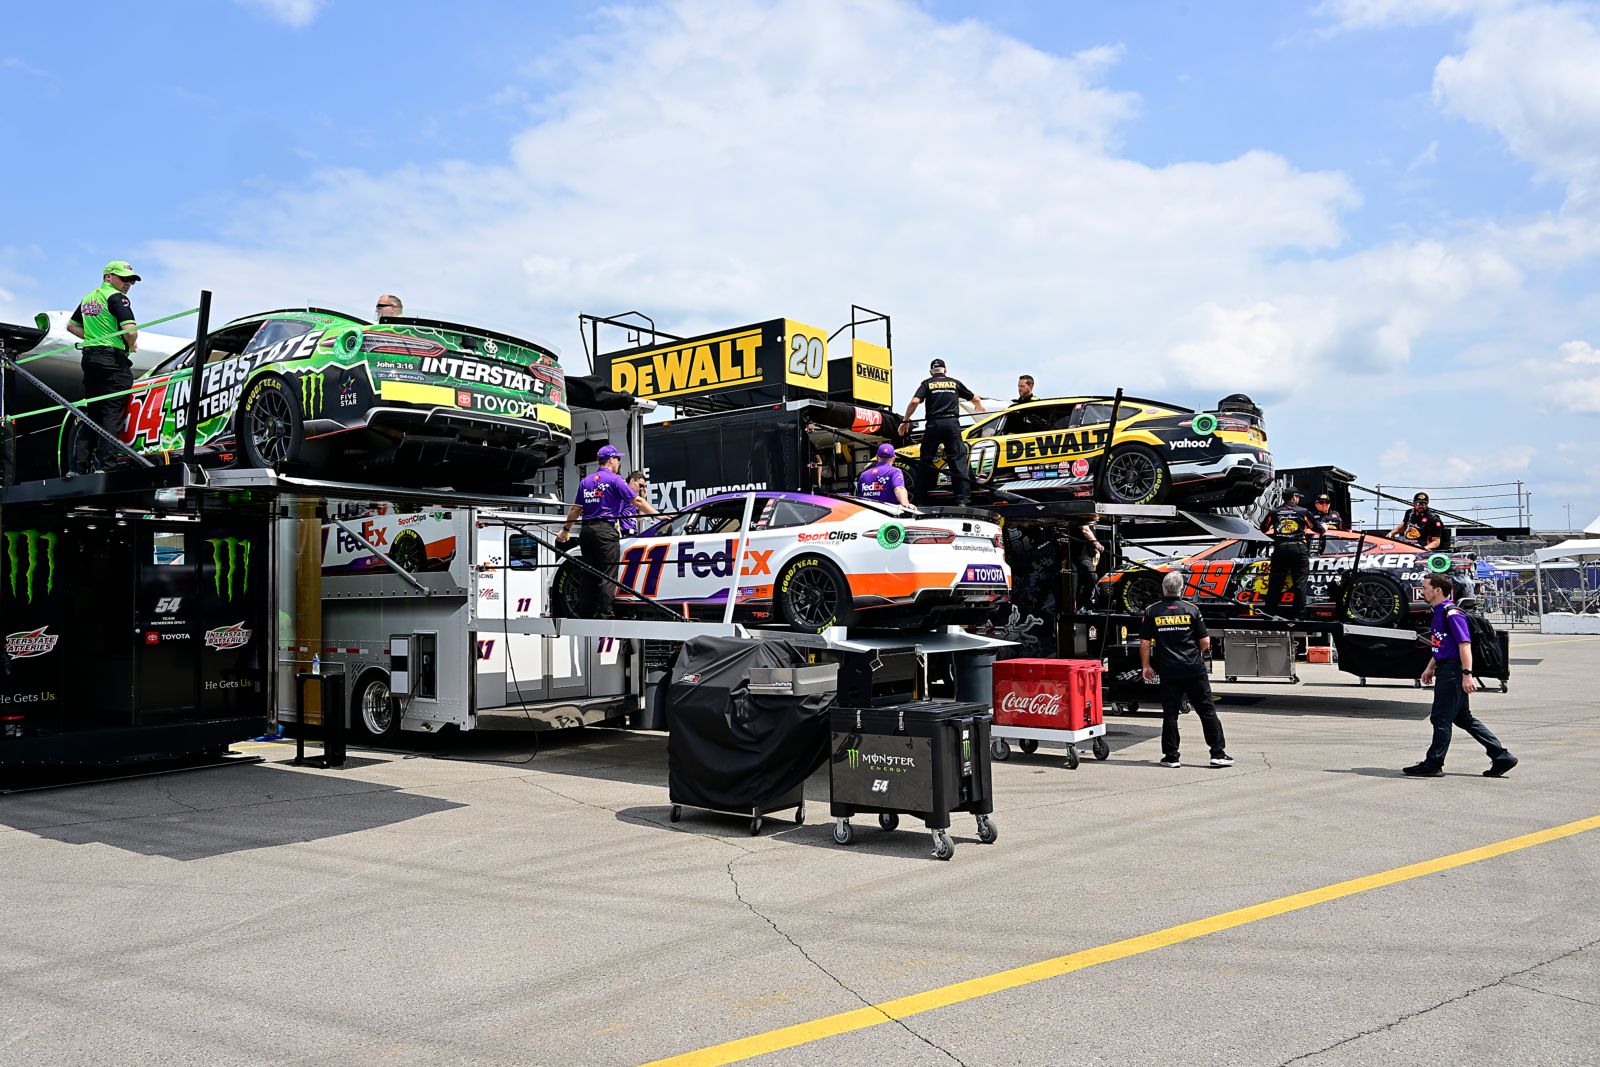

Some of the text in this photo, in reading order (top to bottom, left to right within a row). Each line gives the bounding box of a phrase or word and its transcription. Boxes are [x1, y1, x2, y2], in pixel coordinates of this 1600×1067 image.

[788, 333, 824, 379] 20
[611, 334, 762, 397] DEWALT
[856, 363, 889, 383] DEWALT
[421, 357, 545, 394] INTERSTATE
[340, 392, 357, 400] FIVE
[340, 399, 357, 407] STAR
[474, 394, 536, 419] TOYOTA
[1006, 429, 1110, 460] DEWALT
[1169, 437, 1213, 450] yahoo!
[862, 482, 885, 491] FedEx
[646, 480, 686, 513] EXT
[337, 520, 388, 554] FedEx
[677, 538, 774, 578] FedEx
[616, 542, 671, 598] 11
[781, 559, 819, 593] GOODYEAR
[975, 568, 1004, 582] TOYOTA
[1401, 571, 1425, 581] BOA
[1184, 560, 1234, 597] 19
[155, 597, 182, 613] 54
[516, 598, 532, 613] 11
[1154, 615, 1191, 627] DEWALT
[7, 644, 53, 652] ATTERIES
[8, 637, 57, 645] TERSTATE
[597, 636, 614, 654] 11
[205, 681, 218, 690] He
[219, 680, 239, 689] Gets
[13, 693, 39, 703] Gets
[1001, 691, 1063, 716] Coca-Cola
[862, 753, 915, 768] MONSTER
[871, 779, 889, 793] 54
